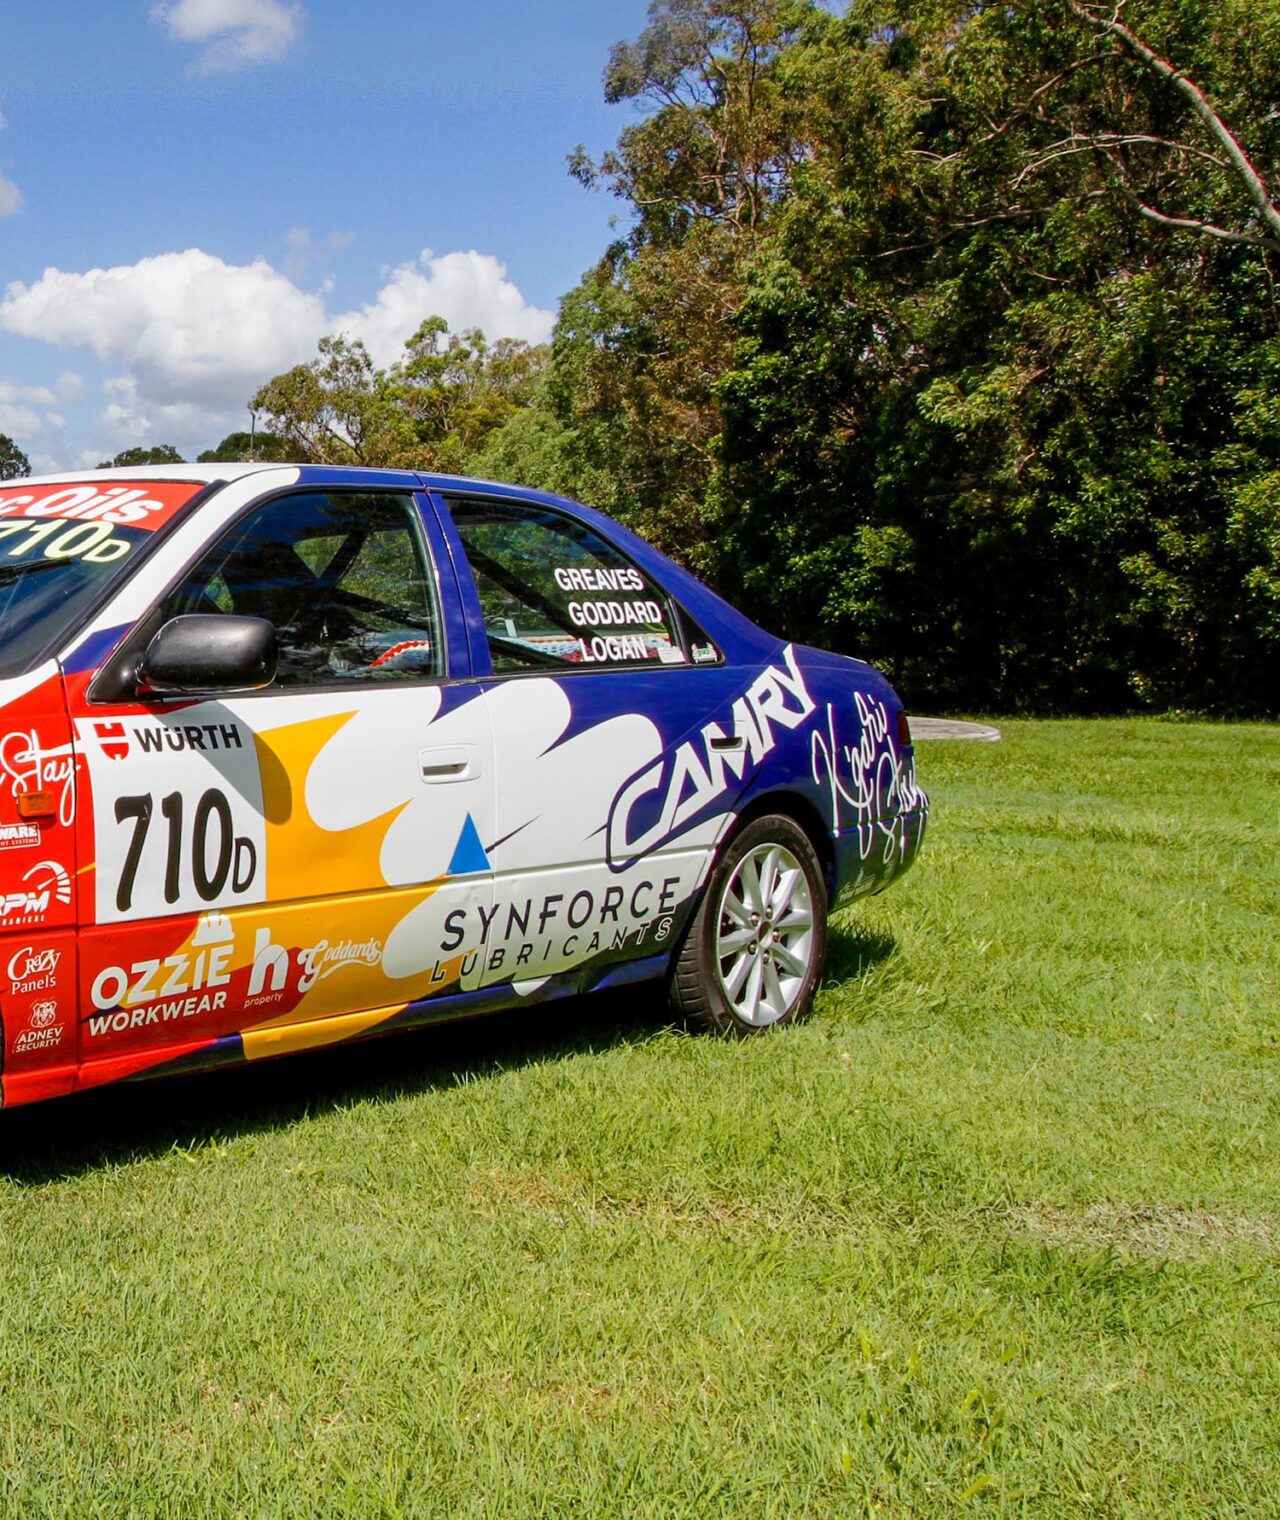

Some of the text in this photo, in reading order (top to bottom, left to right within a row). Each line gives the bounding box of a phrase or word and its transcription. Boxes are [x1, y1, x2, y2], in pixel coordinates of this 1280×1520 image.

[25, 486, 164, 523] Oils
[554, 568, 644, 591] GREAVES
[569, 601, 662, 626] GODDARD
[579, 636, 648, 662] LOGAN
[133, 723, 243, 753] WÜRTH
[609, 643, 816, 867] CAMRY
[11, 837, 39, 846] SYSTEMS
[440, 876, 681, 952] SYNFORCE
[297, 937, 382, 993] Goddards
[428, 918, 673, 984] LUBRICANTS
[11, 974, 56, 995] Panels
[91, 944, 234, 1010] OZZIE
[89, 991, 227, 1037] WORKWEAR
[243, 992, 284, 1009] property
[15, 1037, 61, 1053] SECURITY
[18, 1026, 64, 1045] ADNEV
